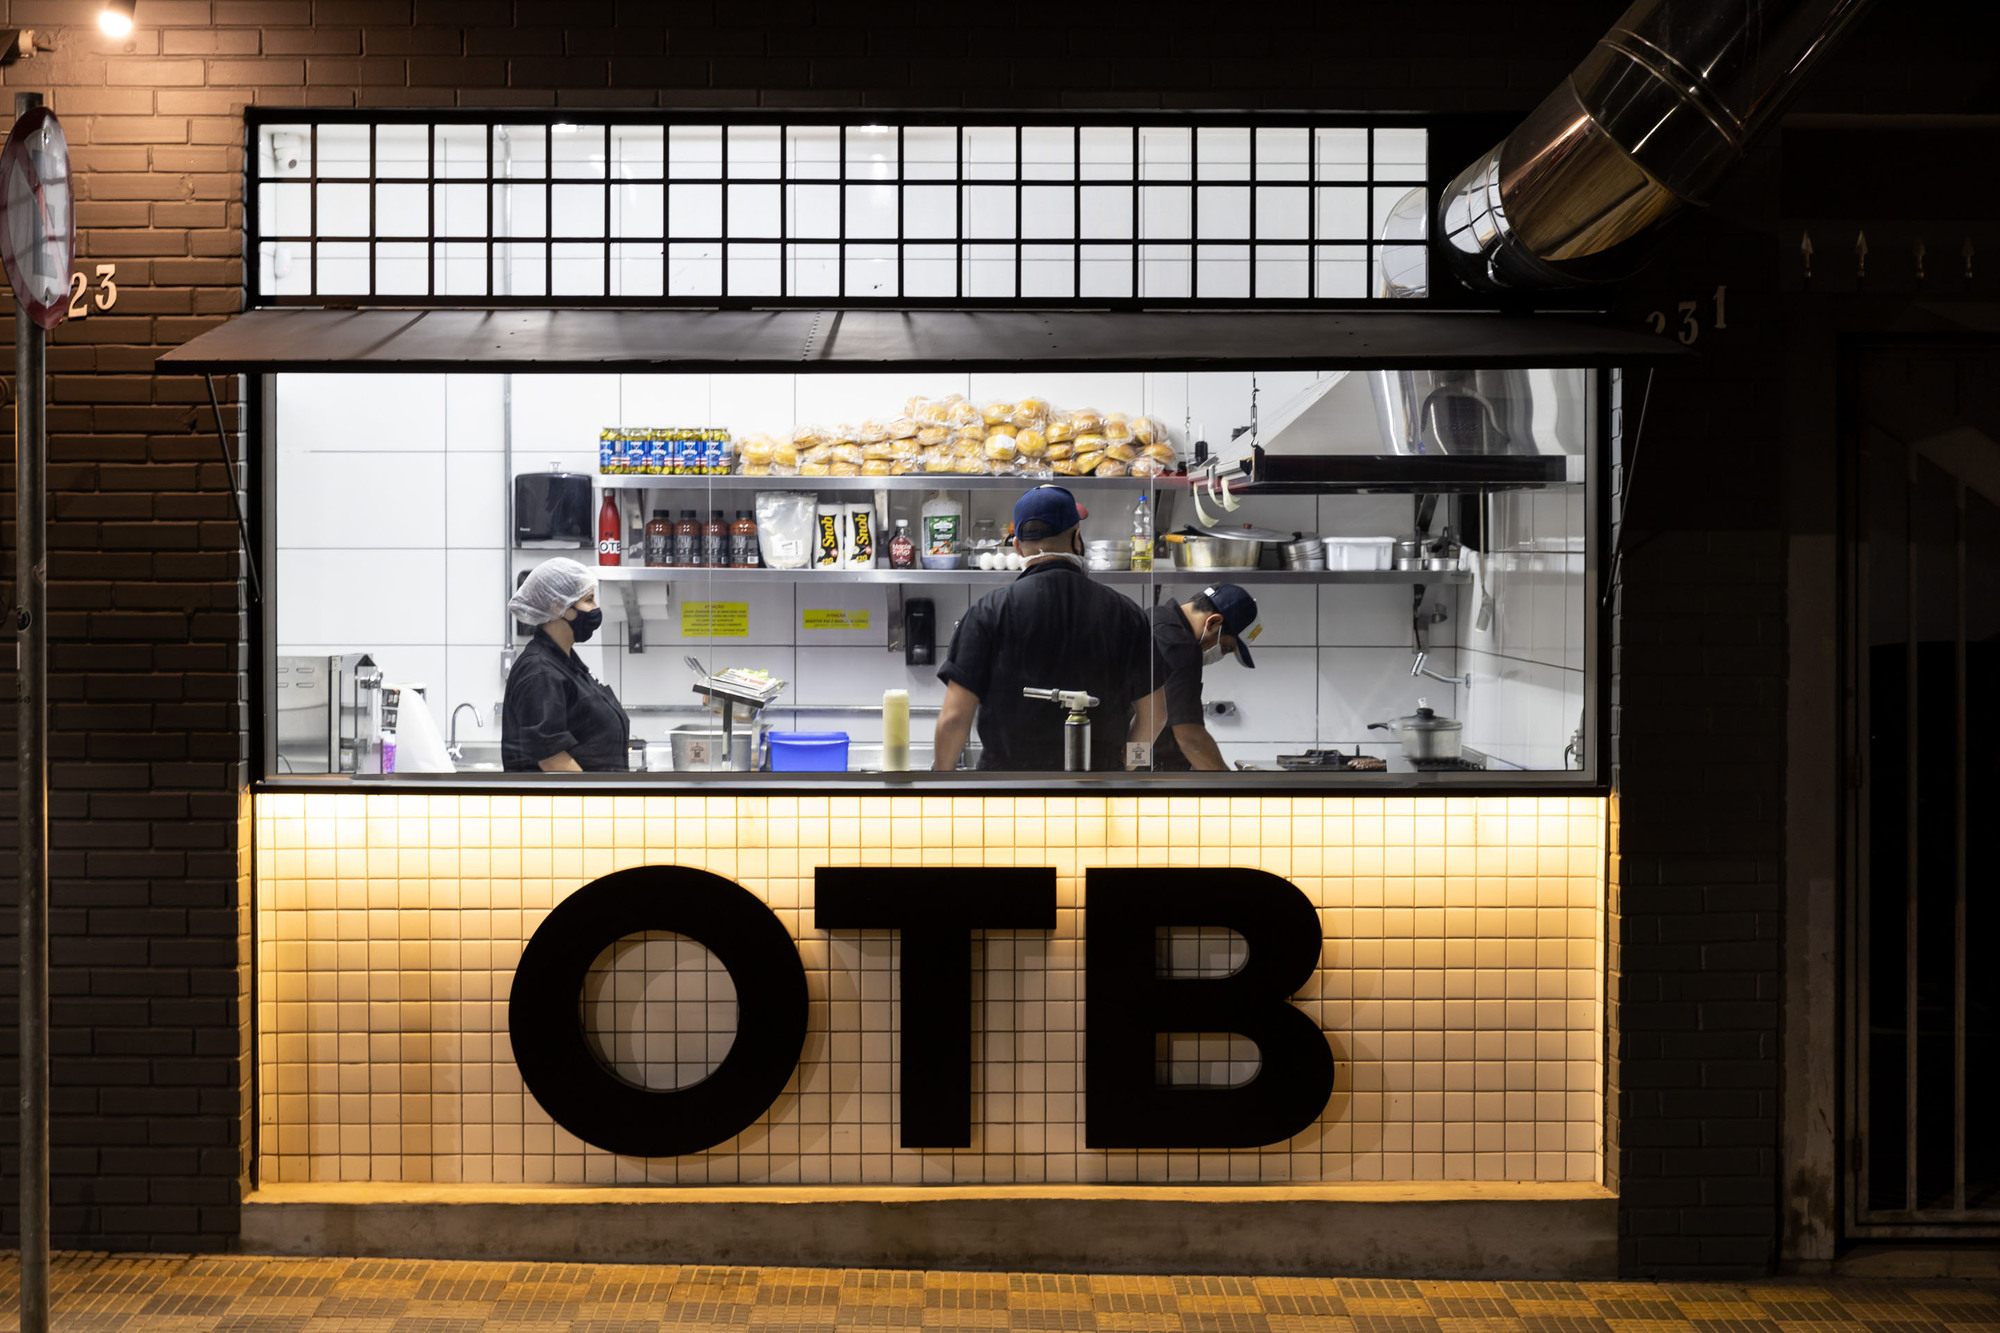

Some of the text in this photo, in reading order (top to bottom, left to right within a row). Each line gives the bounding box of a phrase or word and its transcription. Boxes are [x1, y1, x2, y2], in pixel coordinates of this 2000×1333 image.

[821, 516, 835, 548] Snob
[855, 514, 869, 545] Snob
[508, 865, 1334, 1158] OTB
